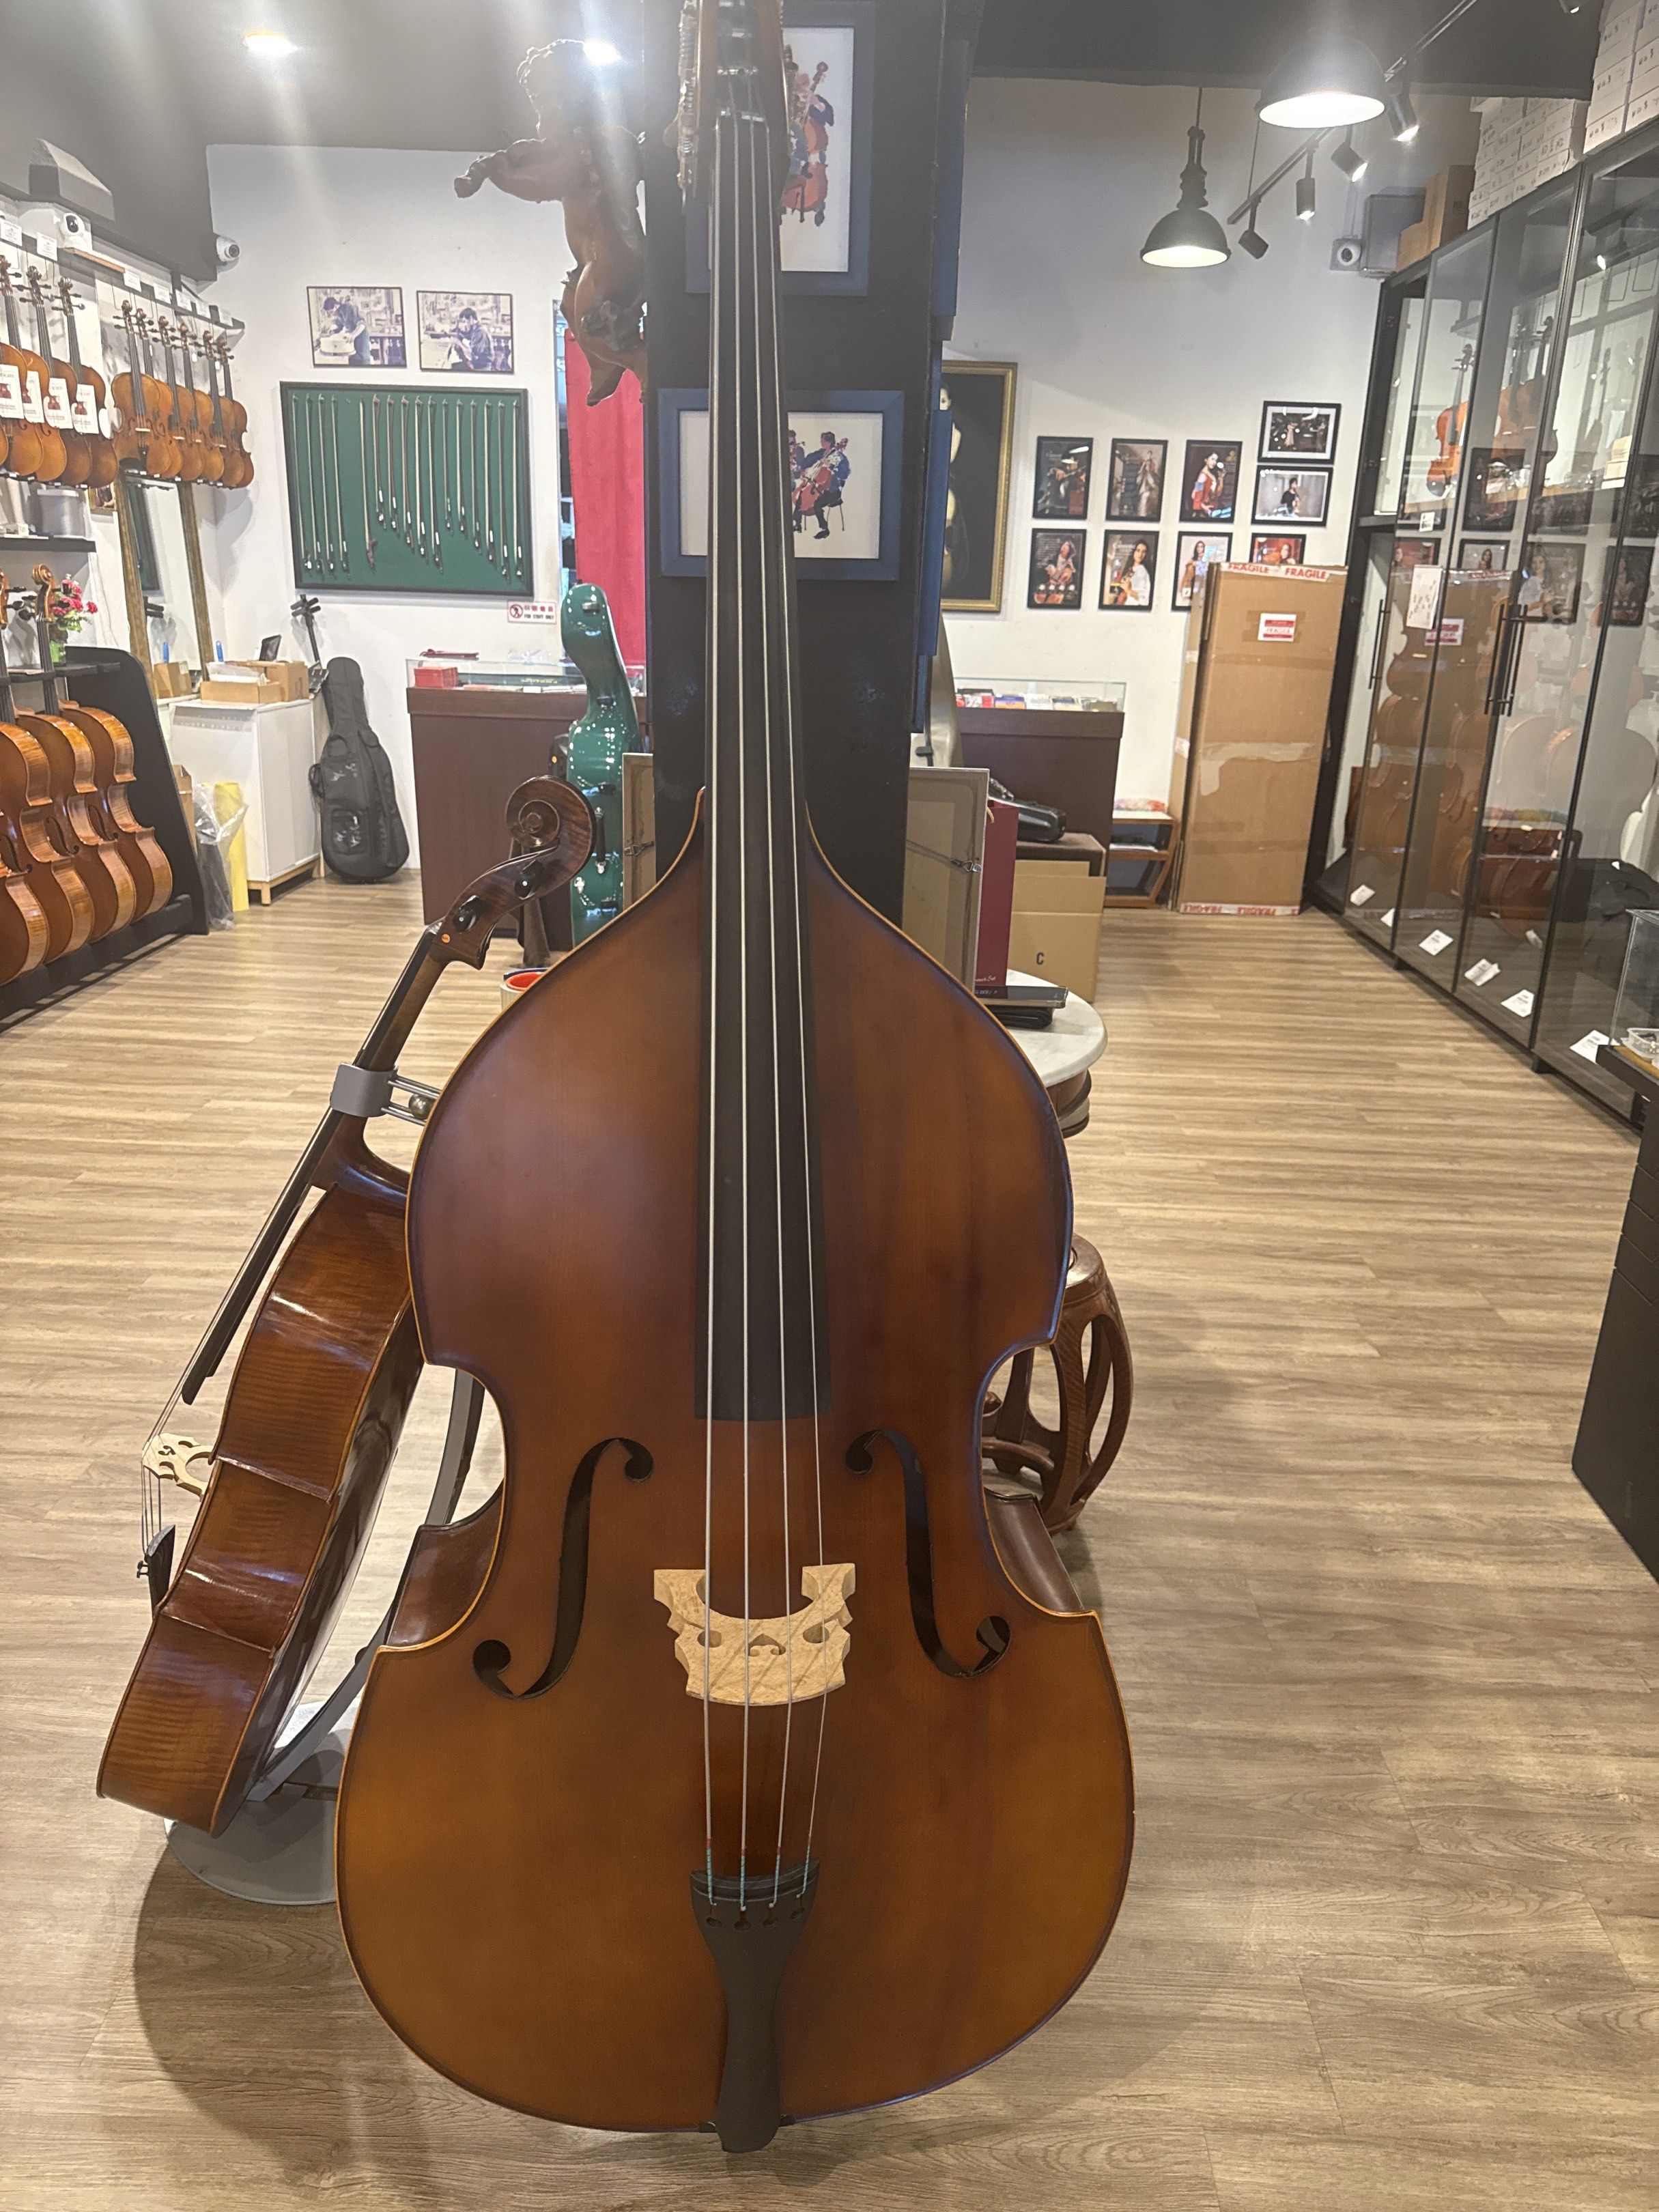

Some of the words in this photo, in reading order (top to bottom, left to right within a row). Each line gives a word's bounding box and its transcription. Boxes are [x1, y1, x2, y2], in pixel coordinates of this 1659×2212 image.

[1228, 563, 1269, 573] FRAGILE
[1285, 567, 1327, 580] FRAGILE
[1036, 952, 1045, 965] C
